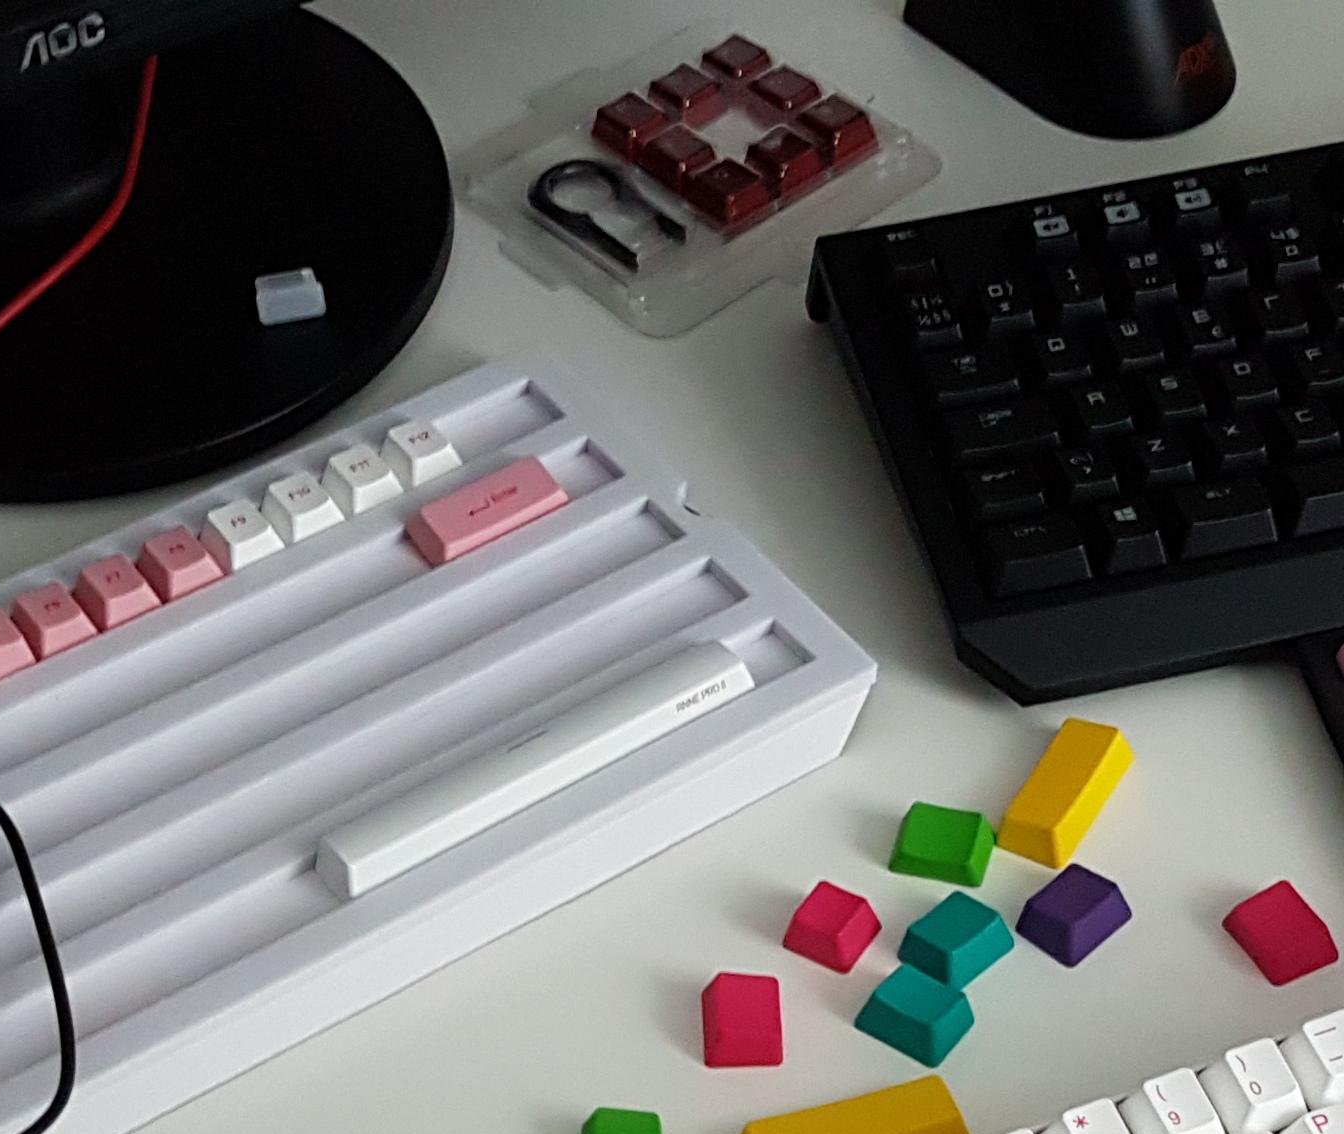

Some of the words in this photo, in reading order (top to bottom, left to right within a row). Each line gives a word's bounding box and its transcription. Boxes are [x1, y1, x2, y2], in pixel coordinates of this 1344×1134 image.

[19, 9, 107, 74] AOC
[1167, 1110, 1182, 1126] 9
[1310, 1113, 1329, 1134] P
